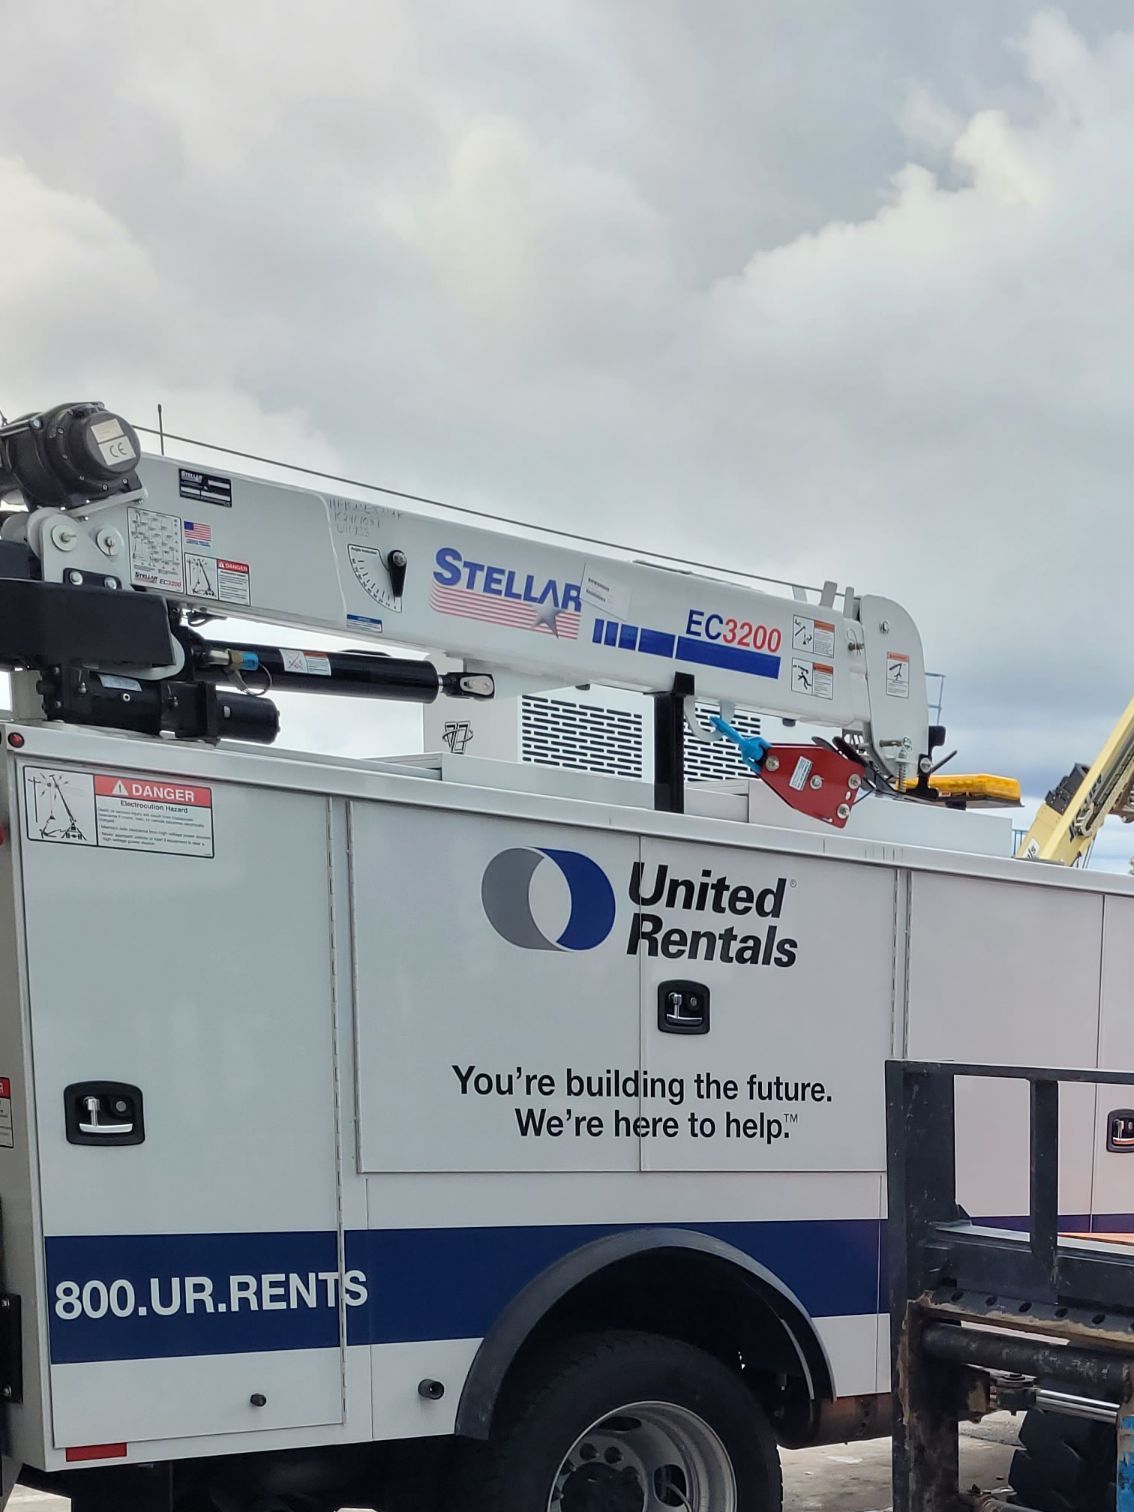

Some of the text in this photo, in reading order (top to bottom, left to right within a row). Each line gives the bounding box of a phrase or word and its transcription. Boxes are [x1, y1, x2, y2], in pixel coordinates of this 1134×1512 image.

[433, 547, 581, 613] STELLAR
[686, 609, 782, 653] EC3200
[120, 799, 188, 814] Electrocution Hazard
[132, 783, 195, 803] DANGER
[628, 861, 787, 919] United
[626, 912, 798, 968] Rentals
[566, 1067, 685, 1106] building
[694, 1072, 739, 1100] the
[746, 1073, 832, 1102] future.
[613, 1109, 680, 1138] here
[687, 1112, 716, 1138] to
[55, 1269, 368, 1321] 800.UR.RENTS
